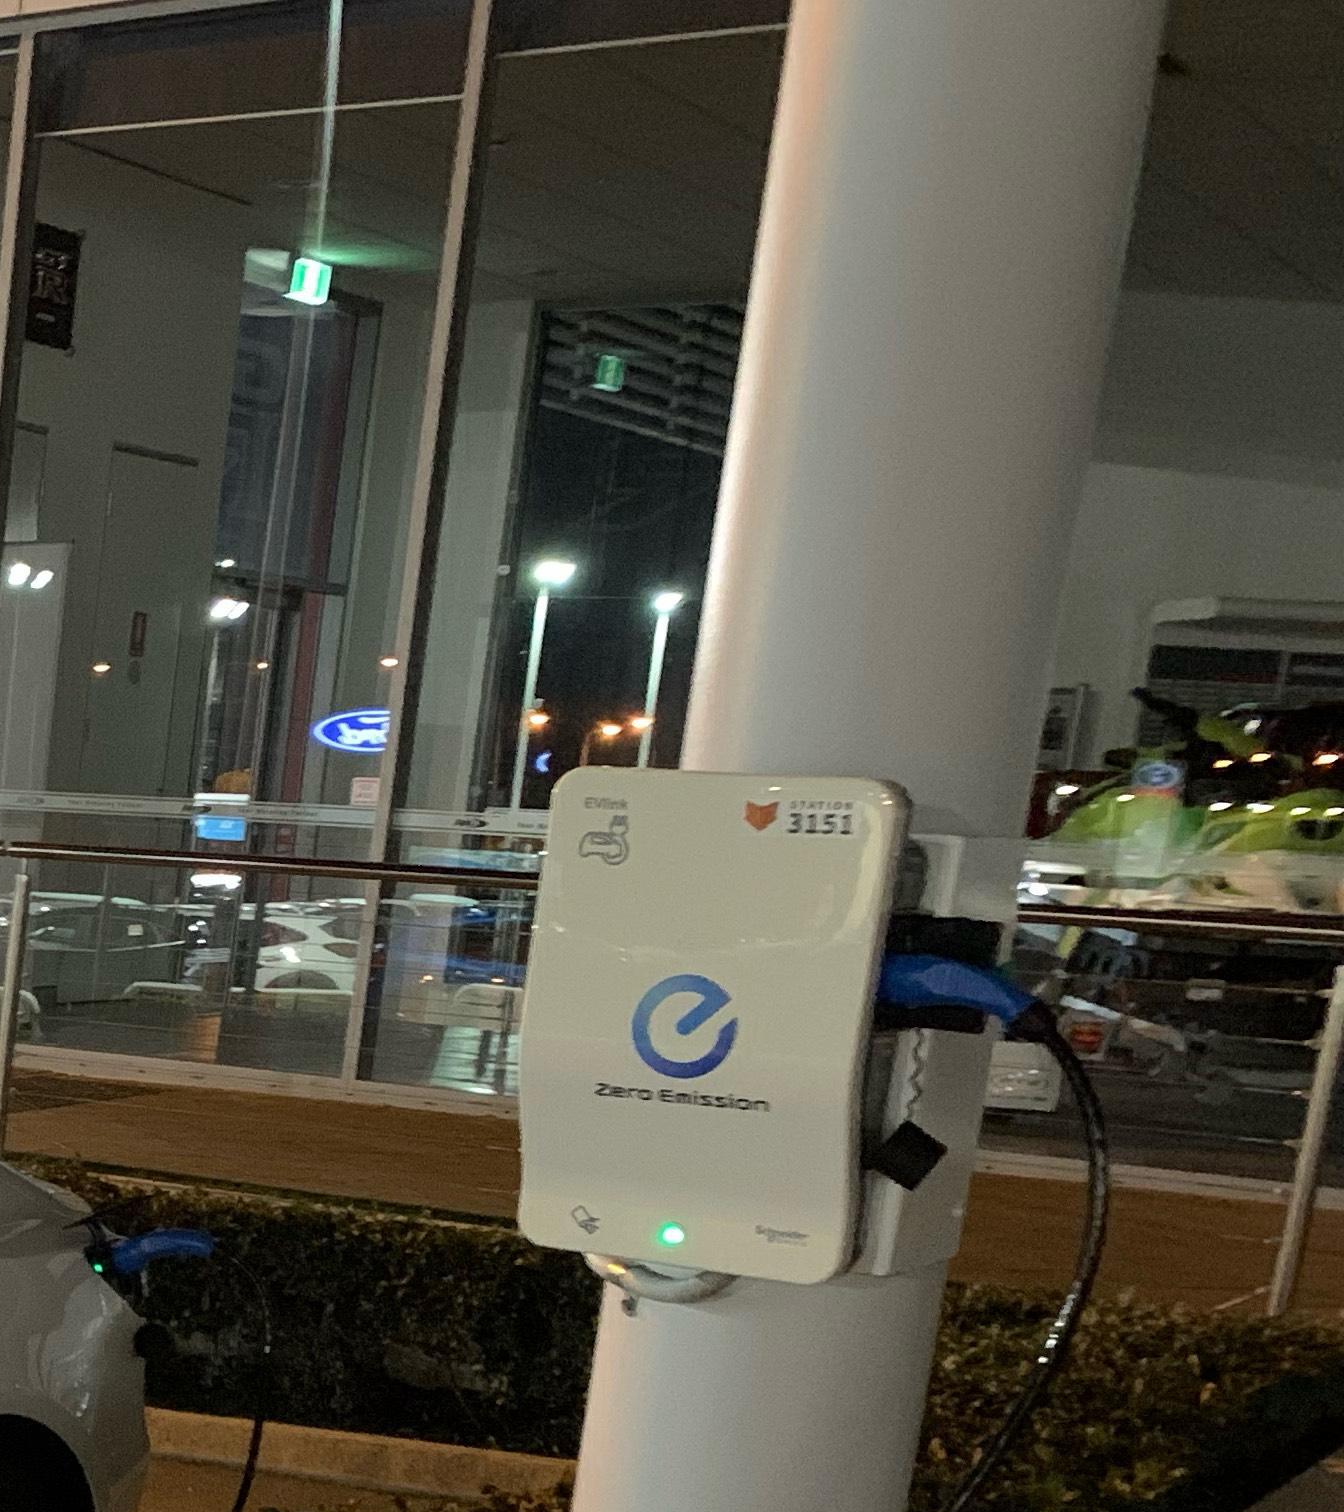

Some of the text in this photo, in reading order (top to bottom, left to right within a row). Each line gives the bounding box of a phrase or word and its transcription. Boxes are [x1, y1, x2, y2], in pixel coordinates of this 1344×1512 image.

[789, 800, 854, 811] STATION
[787, 812, 853, 835] 3151
[593, 1082, 771, 1112] Zero Emission
